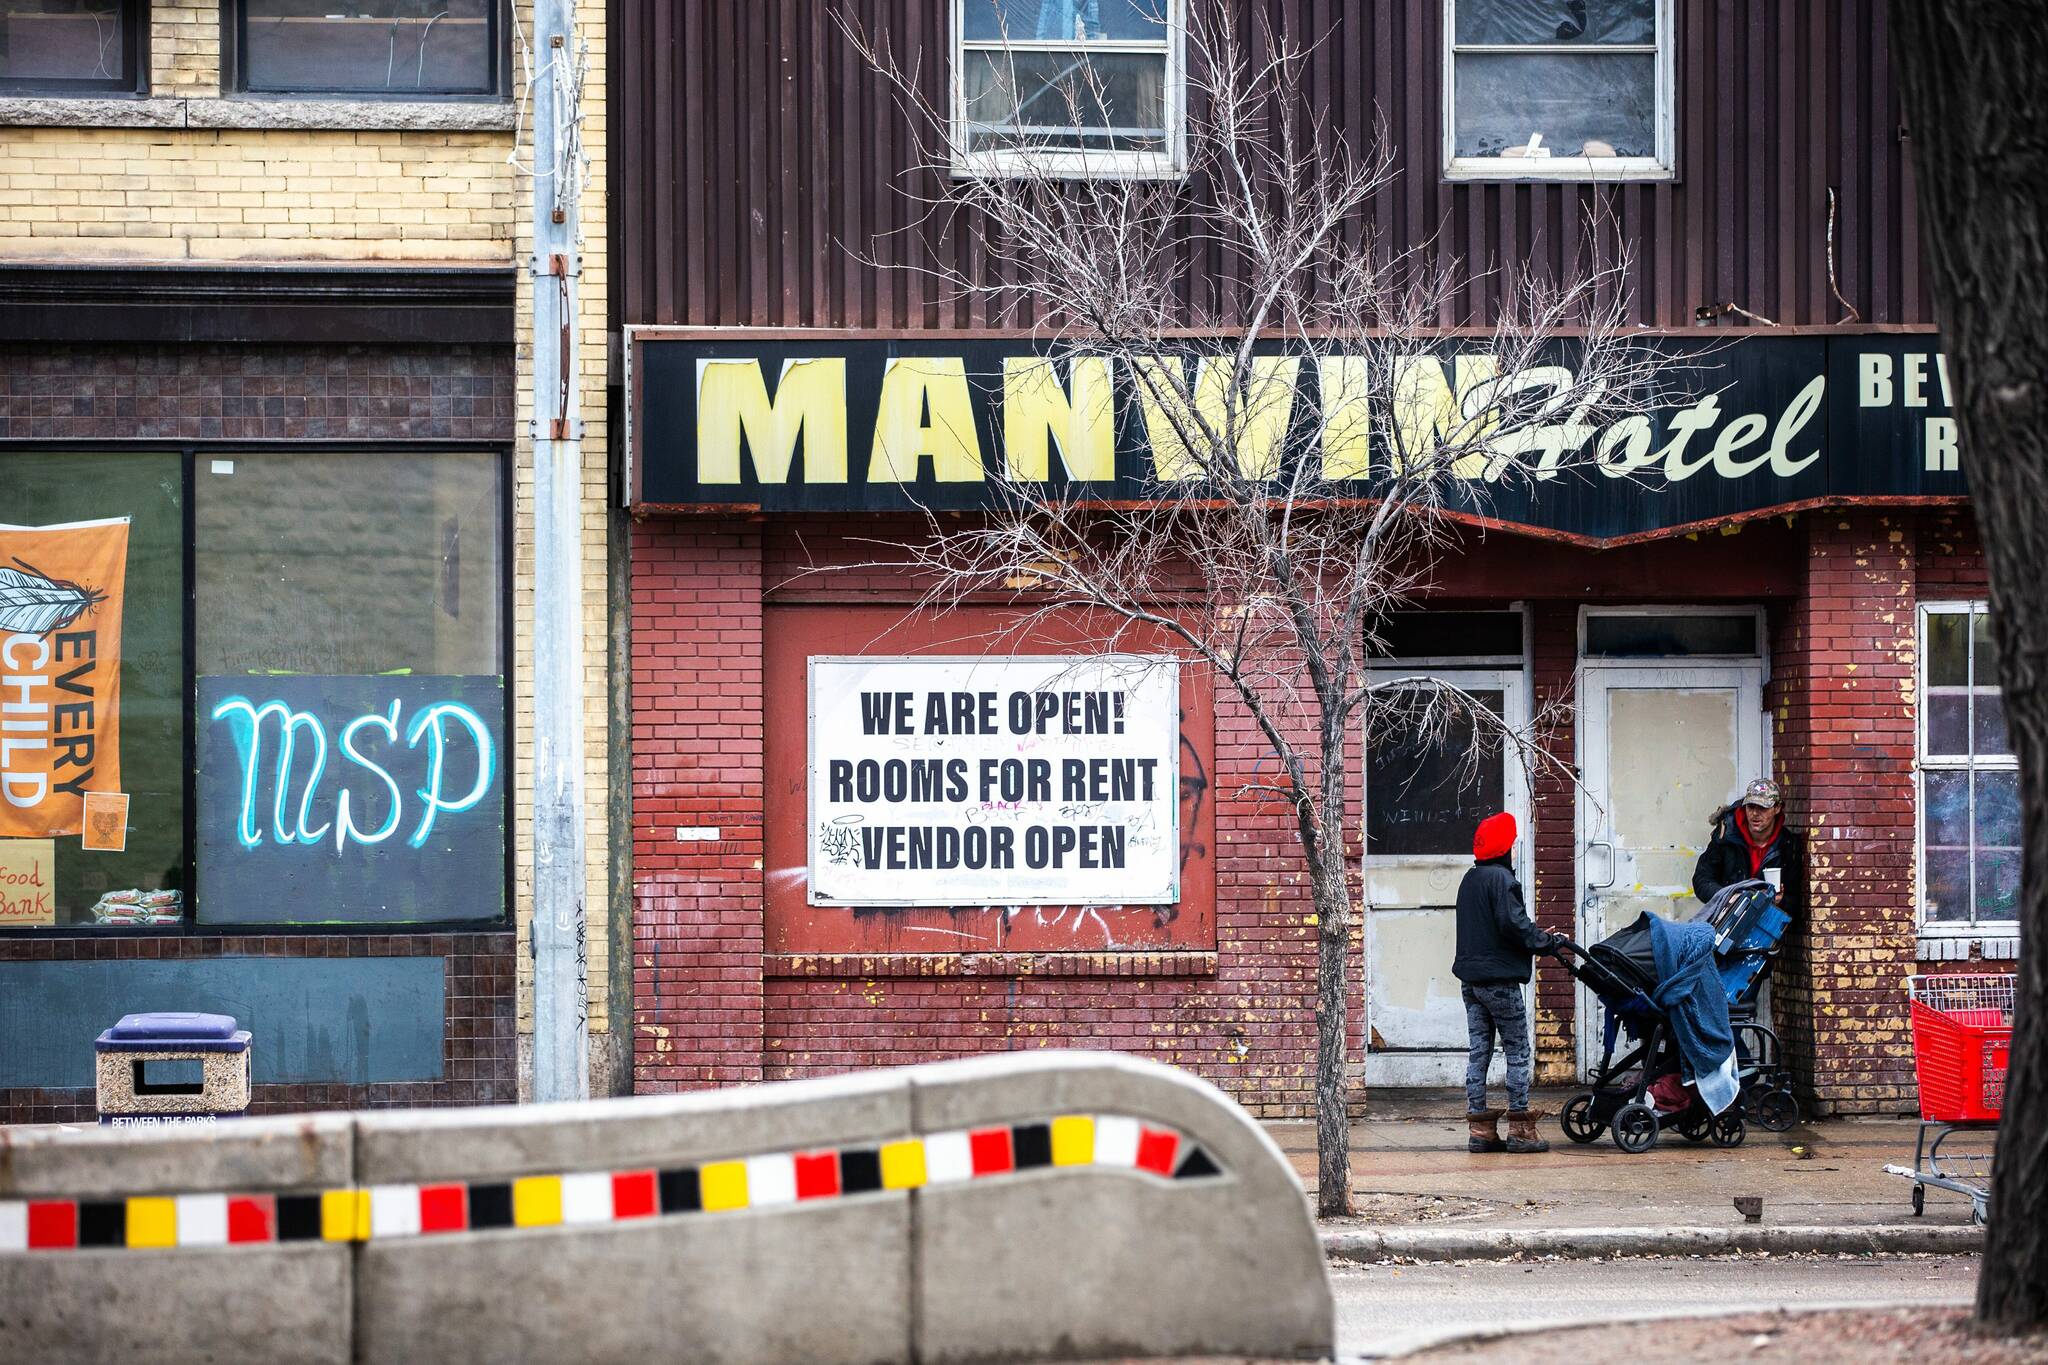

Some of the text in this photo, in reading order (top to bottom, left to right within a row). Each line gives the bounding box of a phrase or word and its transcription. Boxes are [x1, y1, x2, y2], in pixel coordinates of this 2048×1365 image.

[696, 356, 1826, 484] MANWIN Hotel
[1, 633, 50, 808] CHILD
[53, 629, 96, 798] EVERY
[861, 691, 1125, 735] WE ARE OPEN!
[830, 758, 968, 802] ROOMS
[979, 758, 1051, 802] FOR
[1063, 758, 1158, 802] RENT
[862, 826, 1018, 869] VENDOR
[1025, 825, 1125, 869] OPEN
[111, 1115, 217, 1129] BETWEEN THE PARKS
